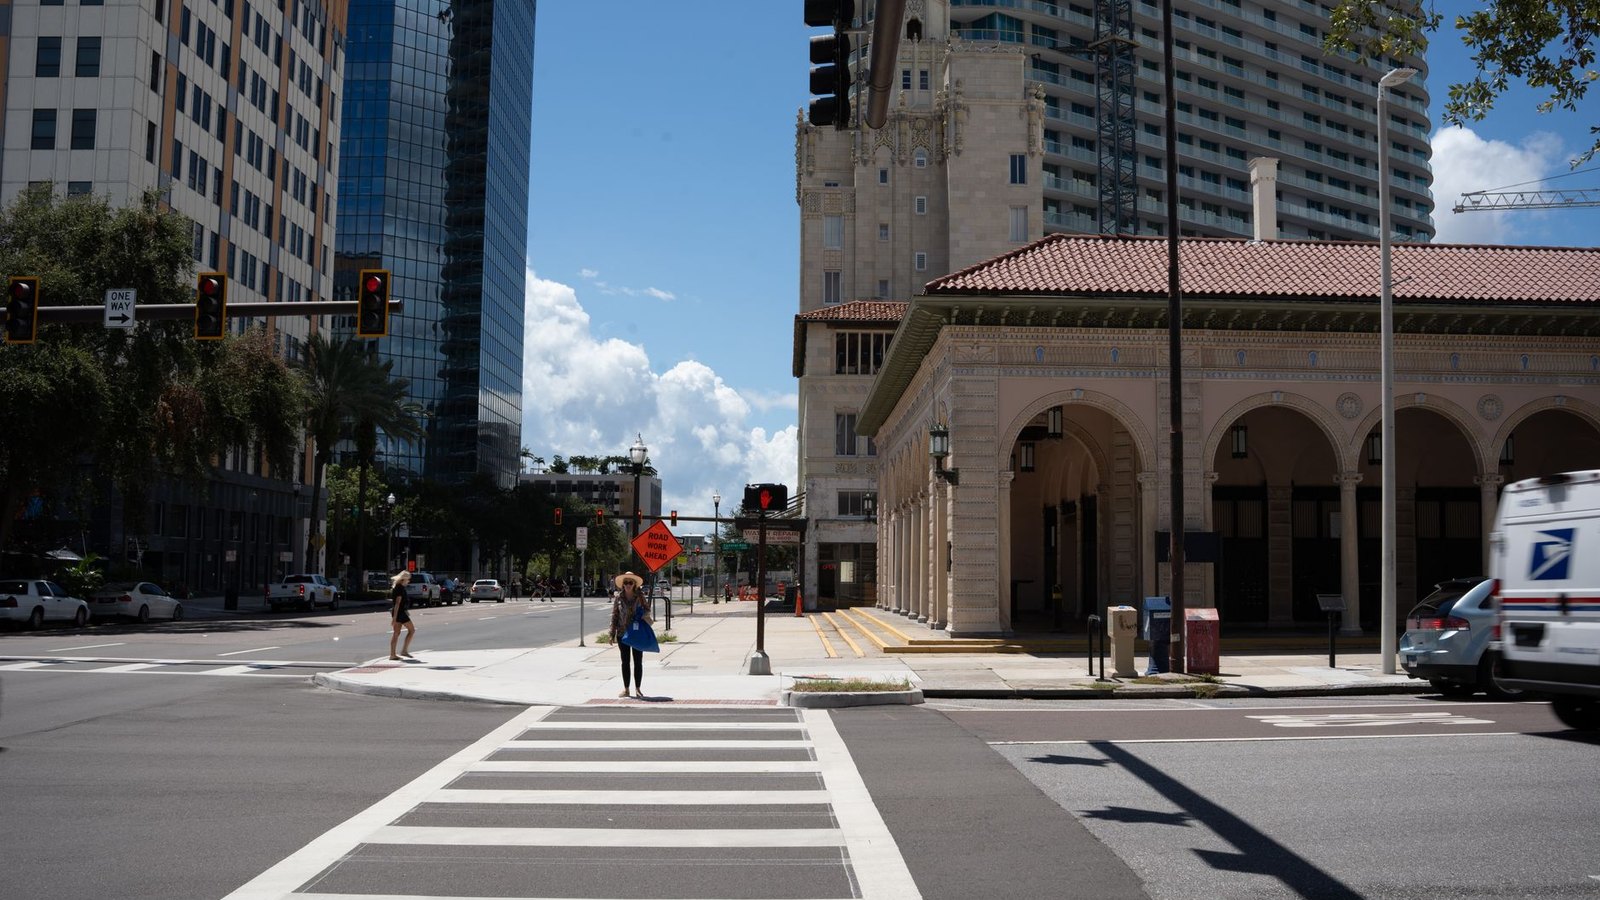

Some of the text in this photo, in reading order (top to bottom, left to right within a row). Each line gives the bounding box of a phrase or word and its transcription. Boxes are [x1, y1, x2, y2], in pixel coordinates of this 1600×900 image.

[111, 291, 131, 300] ONE
[111, 301, 131, 310] WAY
[648, 532, 669, 541] ROAD
[647, 542, 667, 551] WORK
[644, 551, 668, 561] AHEAD
